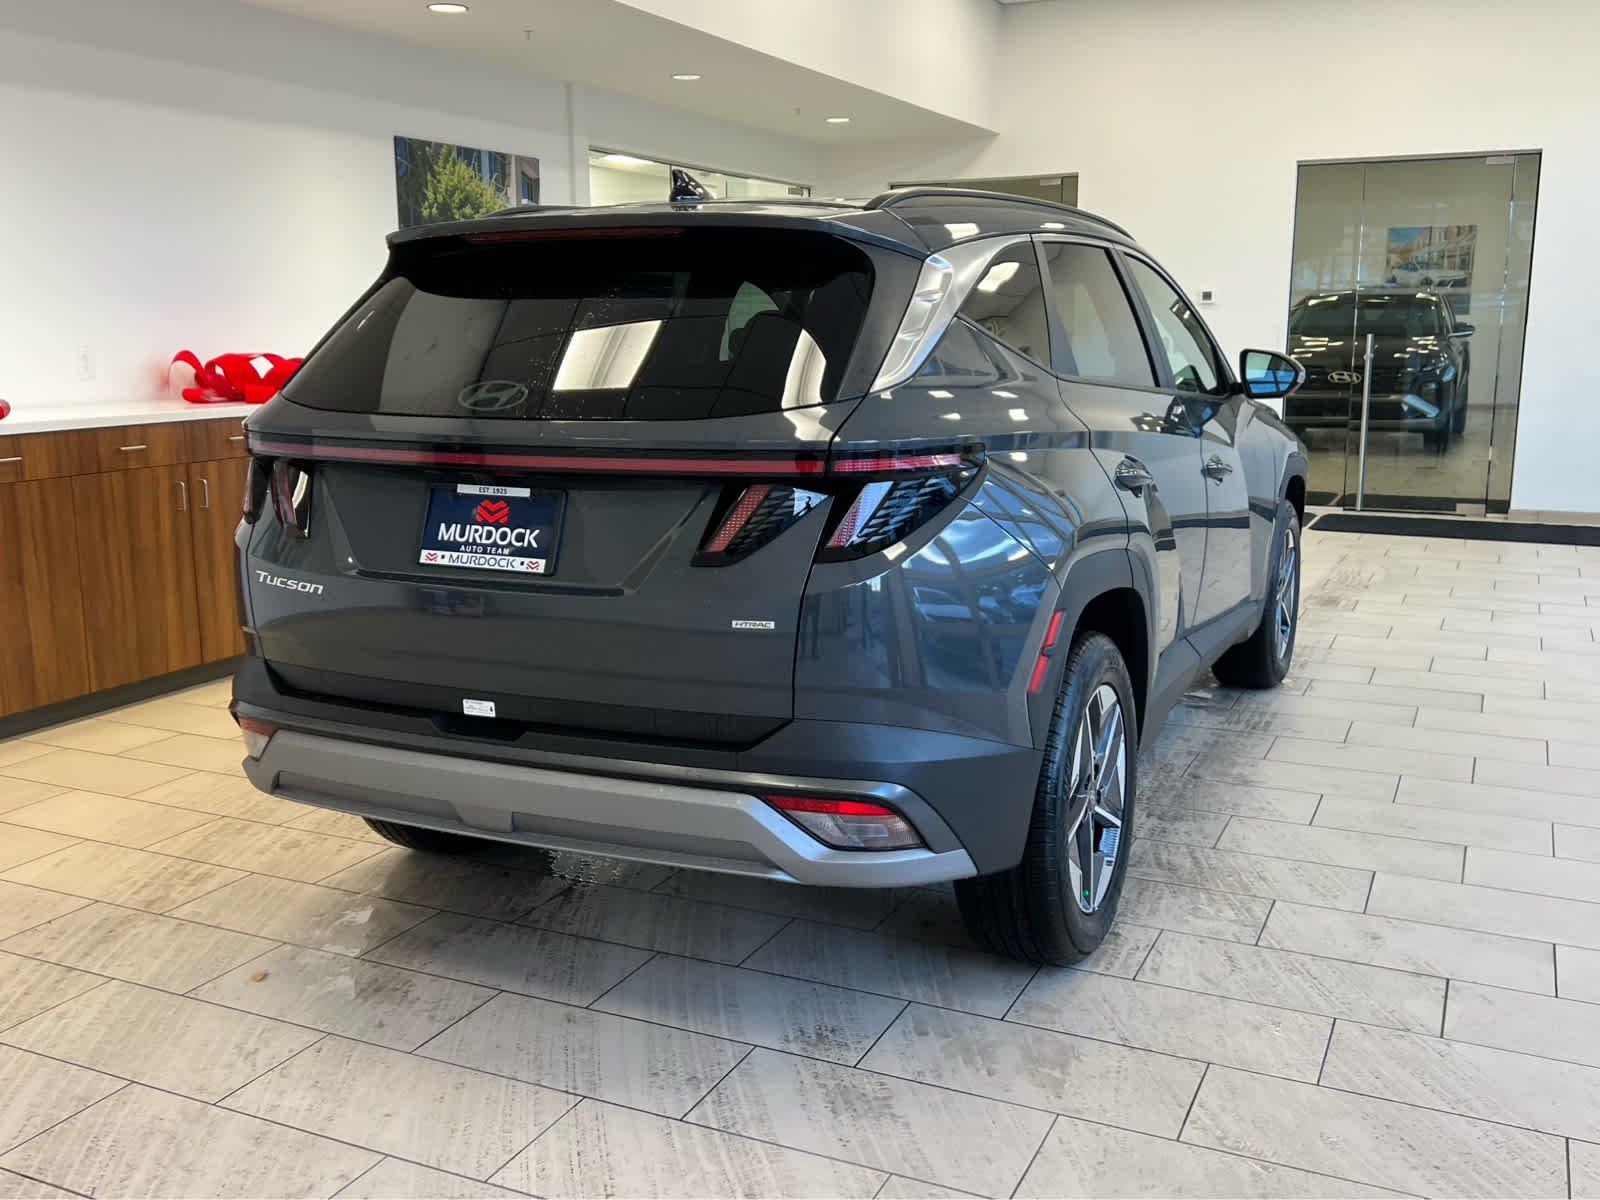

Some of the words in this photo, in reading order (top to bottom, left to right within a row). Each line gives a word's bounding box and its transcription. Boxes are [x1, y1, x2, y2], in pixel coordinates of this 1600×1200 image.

[437, 523, 540, 548] MURDOCK
[459, 544, 483, 553] AUTO
[486, 546, 510, 555] TEAM
[448, 554, 517, 568] MURDOCK
[733, 620, 774, 629] HTRAC
